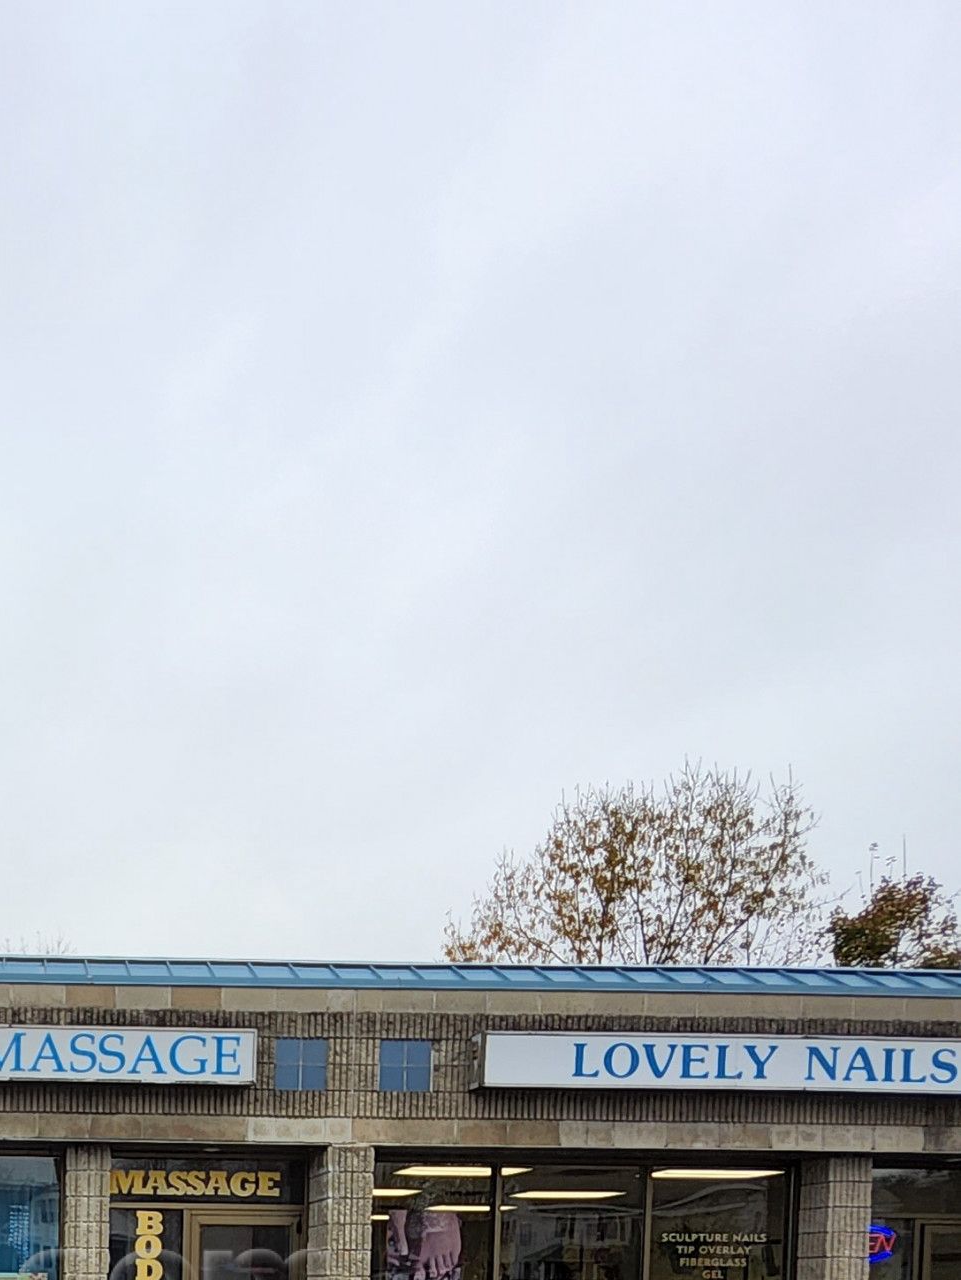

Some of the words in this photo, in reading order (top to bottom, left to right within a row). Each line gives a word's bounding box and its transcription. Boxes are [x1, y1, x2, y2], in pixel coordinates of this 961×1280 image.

[572, 1043, 778, 1079] LOVELY
[804, 1046, 959, 1084] NAILS
[110, 1170, 281, 1197] MASSAGE
[661, 1233, 728, 1243] SCULPTURE
[732, 1233, 767, 1243] NAILS
[676, 1245, 695, 1254] TIP
[699, 1245, 752, 1255] OVERLAY
[679, 1257, 747, 1267] FIBERGLASS
[702, 1270, 724, 1279] GEL
